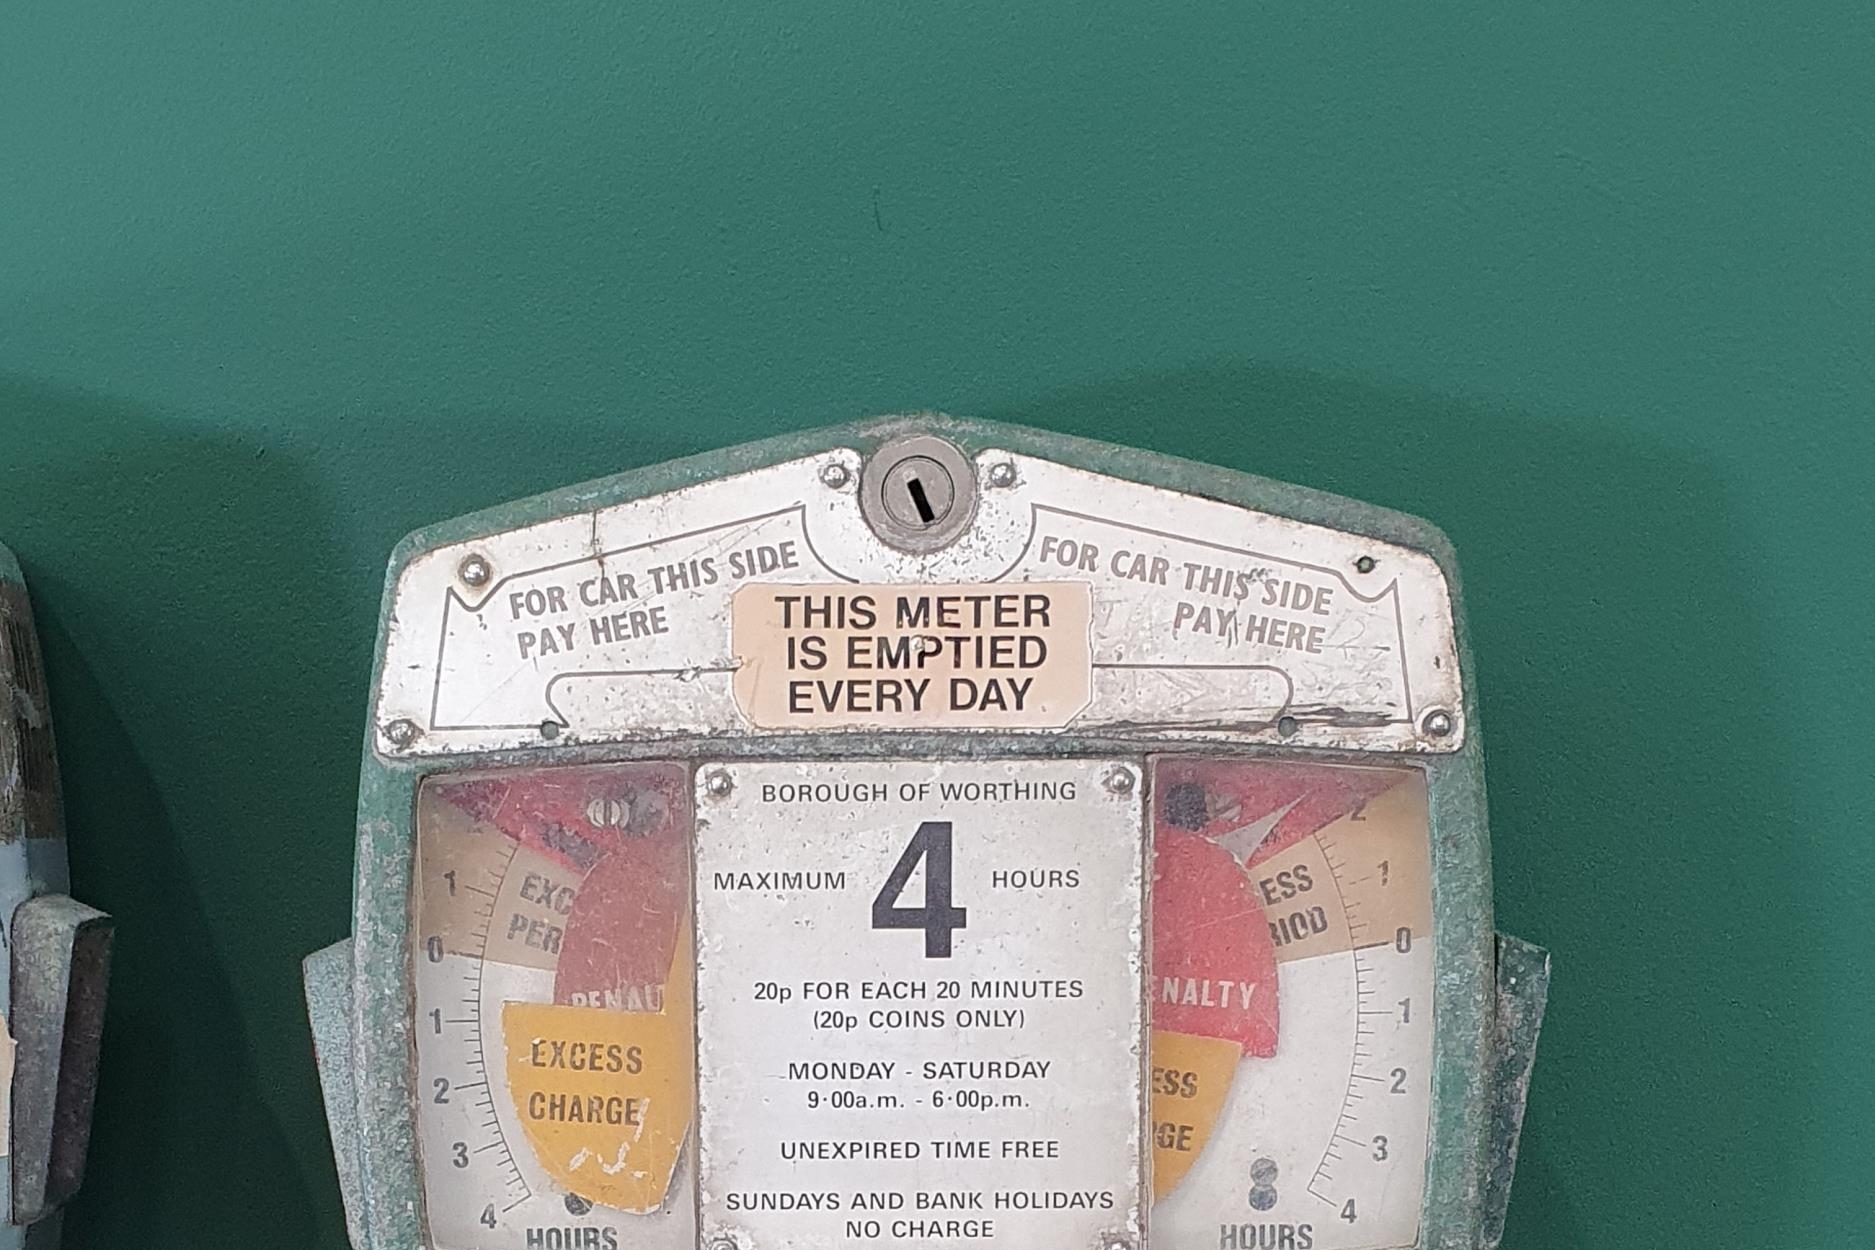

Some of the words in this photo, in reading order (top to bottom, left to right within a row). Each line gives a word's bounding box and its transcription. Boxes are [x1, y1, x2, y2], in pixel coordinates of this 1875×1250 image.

[509, 588, 568, 620] FOR
[578, 575, 640, 607] CAR
[647, 559, 718, 595] THIS
[731, 542, 800, 578] SIDE
[1039, 536, 1100, 572] FOR
[1110, 550, 1167, 585] CAR
[1183, 562, 1250, 600] THIS
[1263, 579, 1334, 615] SIDE
[775, 596, 876, 630] THIS
[896, 595, 1050, 628] METER
[518, 621, 582, 659] PAY
[592, 608, 669, 645] HERE
[1173, 601, 1233, 638] PAY
[1245, 615, 1326, 653] HERE
[788, 636, 827, 670] IS
[848, 635, 1046, 669] EMPTIED
[790, 679, 930, 713] EVERY
[950, 678, 1033, 711] DAY
[763, 784, 887, 802] BOROUGH
[900, 784, 930, 801] OF
[940, 780, 1075, 804] WORTHING
[443, 872, 455, 896] 1
[1260, 864, 1314, 906] ESS
[1376, 860, 1390, 886] 1
[519, 872, 576, 914] EXC
[715, 872, 844, 890] MAXIMUM
[872, 821, 966, 958] 4
[993, 870, 1079, 891] HOURS
[507, 914, 562, 954] PER
[1270, 906, 1329, 947] RIOD
[427, 936, 444, 963] 0
[1395, 927, 1412, 954] 0
[755, 983, 791, 1003] 20p
[804, 982, 849, 999] FOR
[862, 982, 925, 999] EACH
[937, 981, 960, 998] 20
[972, 980, 1083, 998] MINUTES
[1151, 974, 1256, 1010] NALTY
[429, 1008, 442, 1033] 1
[814, 1011, 857, 1032] (20p
[869, 1010, 944, 1028] COINS
[956, 1010, 1024, 1028] ONLY)
[1398, 998, 1412, 1023] 1
[532, 1039, 643, 1075] EXCESS
[790, 1062, 894, 1080] MONDAY
[923, 1057, 1050, 1079] SATURDAY
[433, 1078, 450, 1104] 2
[1152, 1067, 1198, 1099] ESS
[1391, 1068, 1407, 1094] 2
[529, 1092, 640, 1127] CHARGE
[452, 1142, 470, 1168] 3
[782, 1142, 920, 1162] UNEXPIRED
[931, 1142, 990, 1158] TIME
[1003, 1141, 1058, 1158] FREE
[1372, 1135, 1388, 1162] 3
[727, 1193, 839, 1210] SUNDAYS
[851, 1193, 903, 1209] AND
[917, 1193, 982, 1209] BANK
[995, 1192, 1113, 1209] HOLIDAYS
[1340, 1198, 1358, 1224] 4
[480, 1204, 497, 1229] 4
[847, 1221, 880, 1238] NO
[892, 1220, 993, 1237] CHARGE
[1220, 1224, 1313, 1250] HOURS
